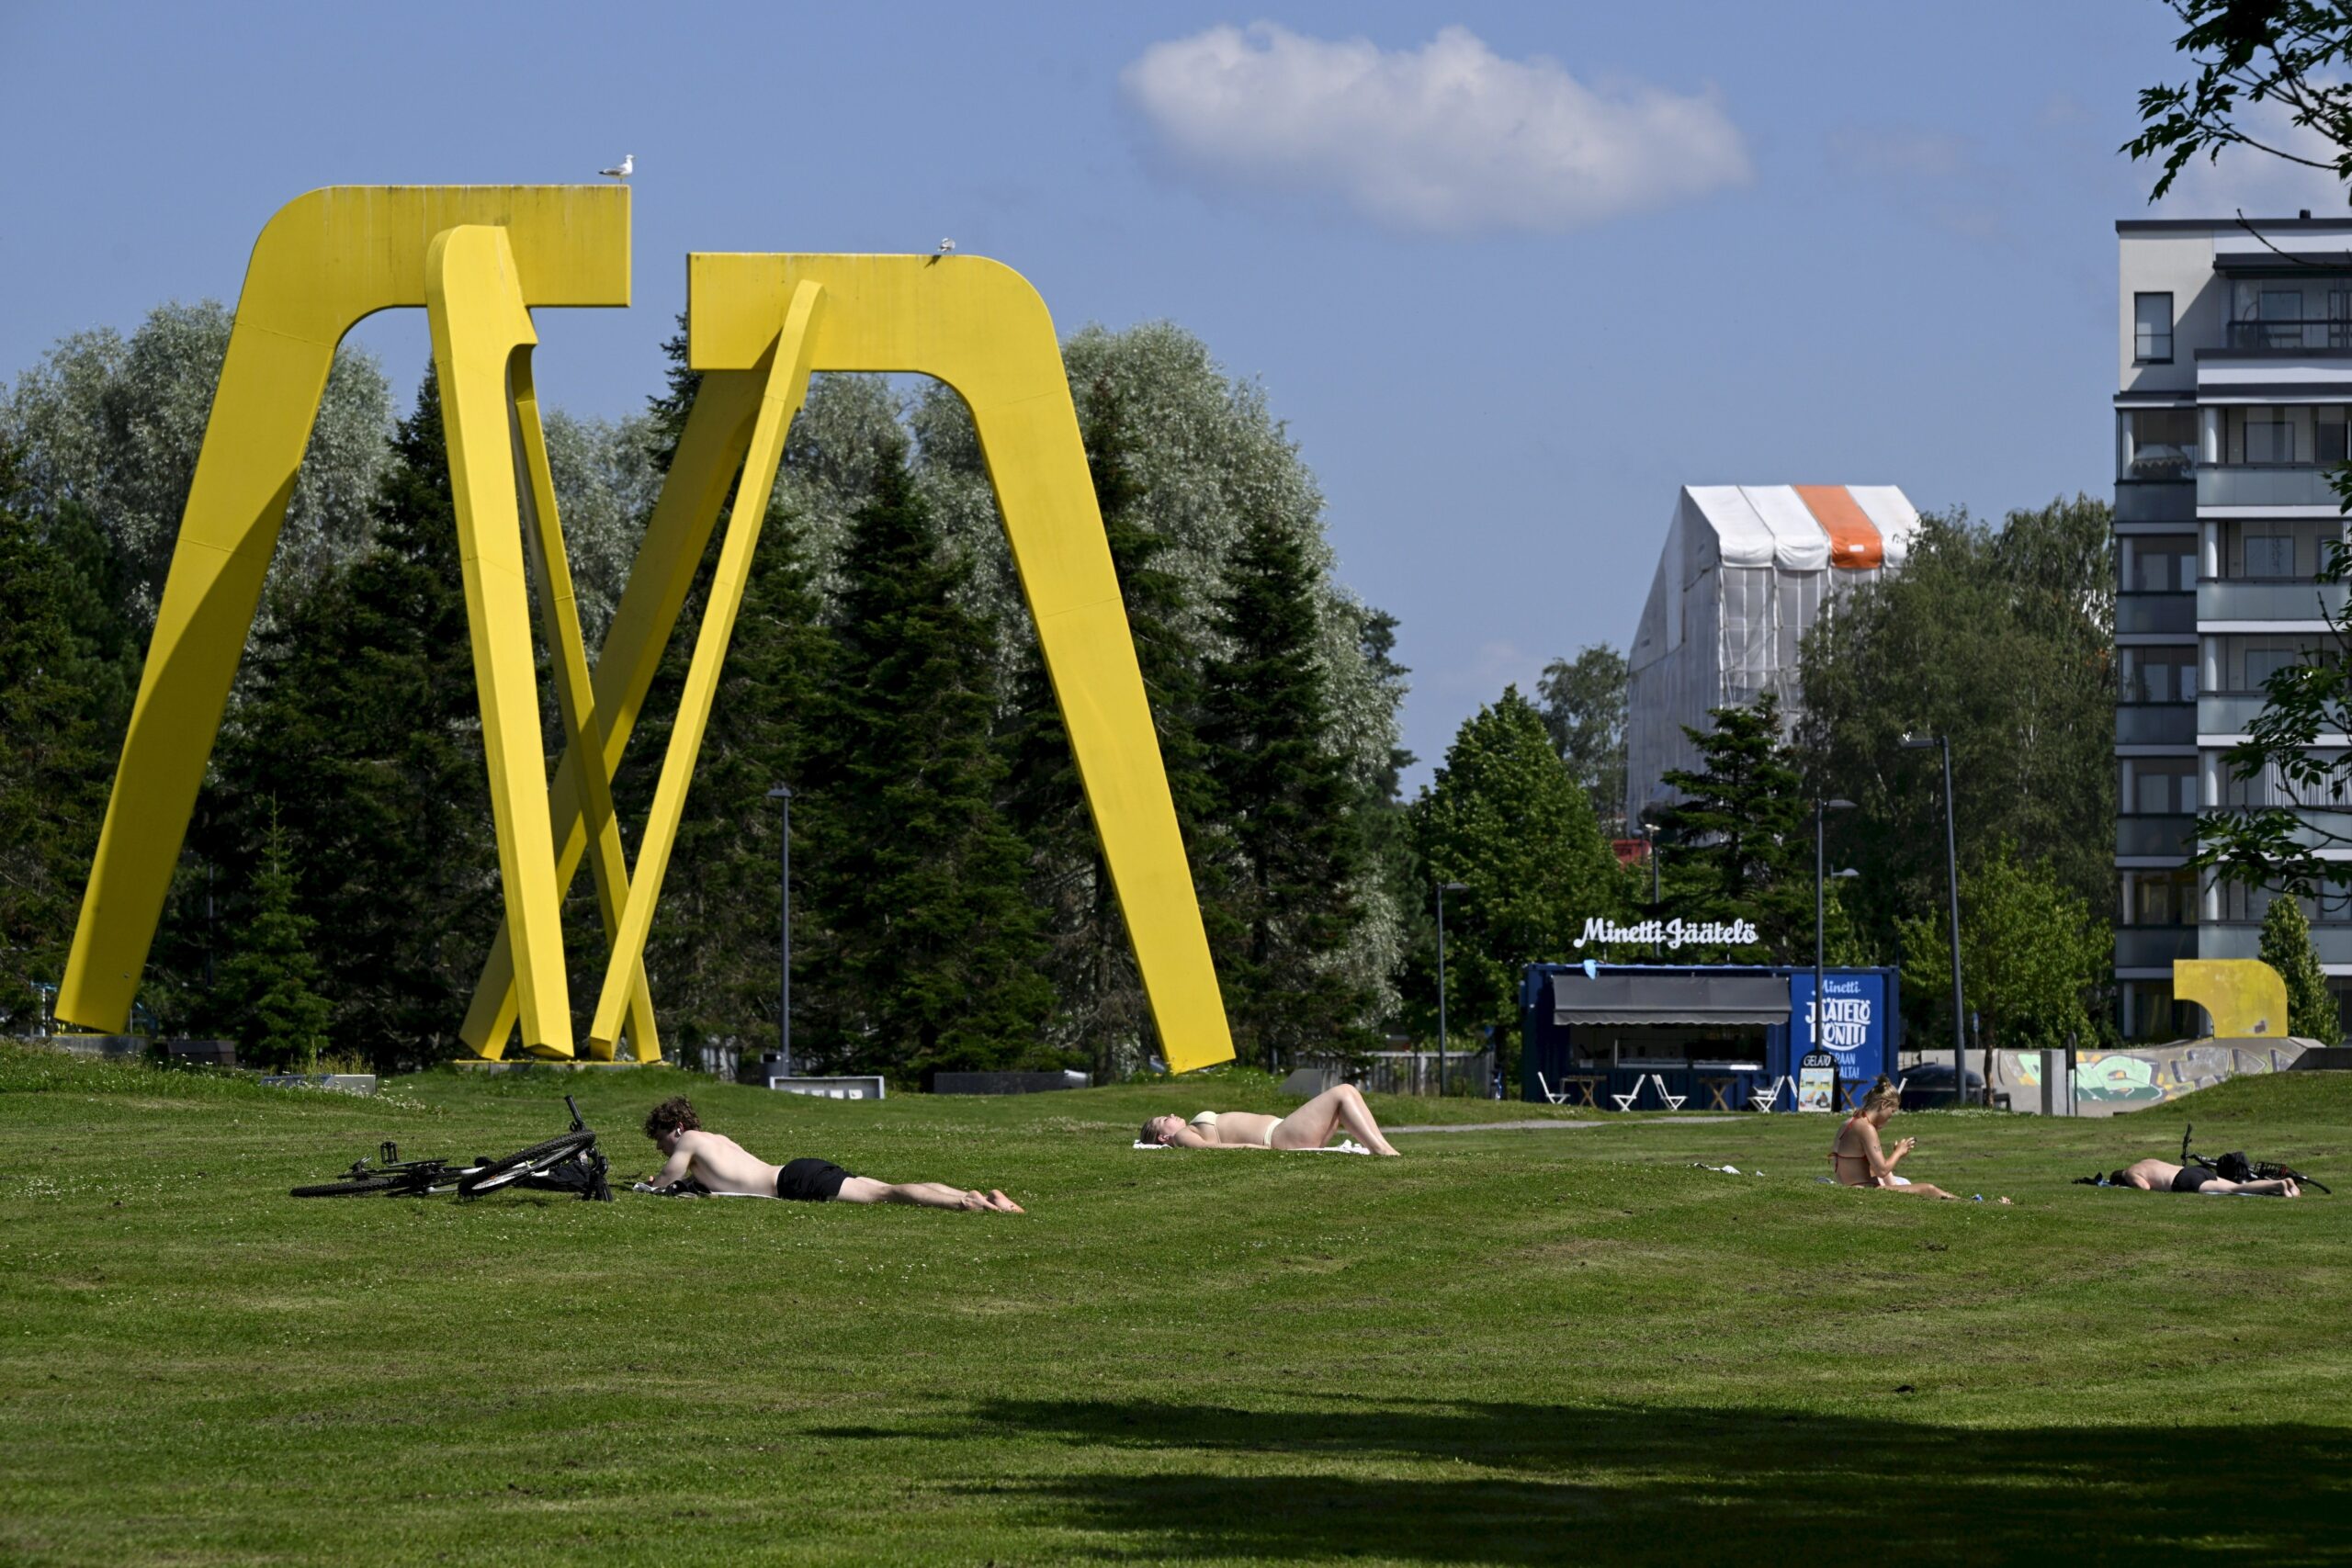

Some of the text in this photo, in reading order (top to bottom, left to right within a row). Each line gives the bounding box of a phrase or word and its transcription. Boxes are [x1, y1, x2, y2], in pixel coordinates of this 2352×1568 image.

[1573, 917, 1758, 949] Minetti Jäätelö
[1804, 1054, 1832, 1066] GELATO
